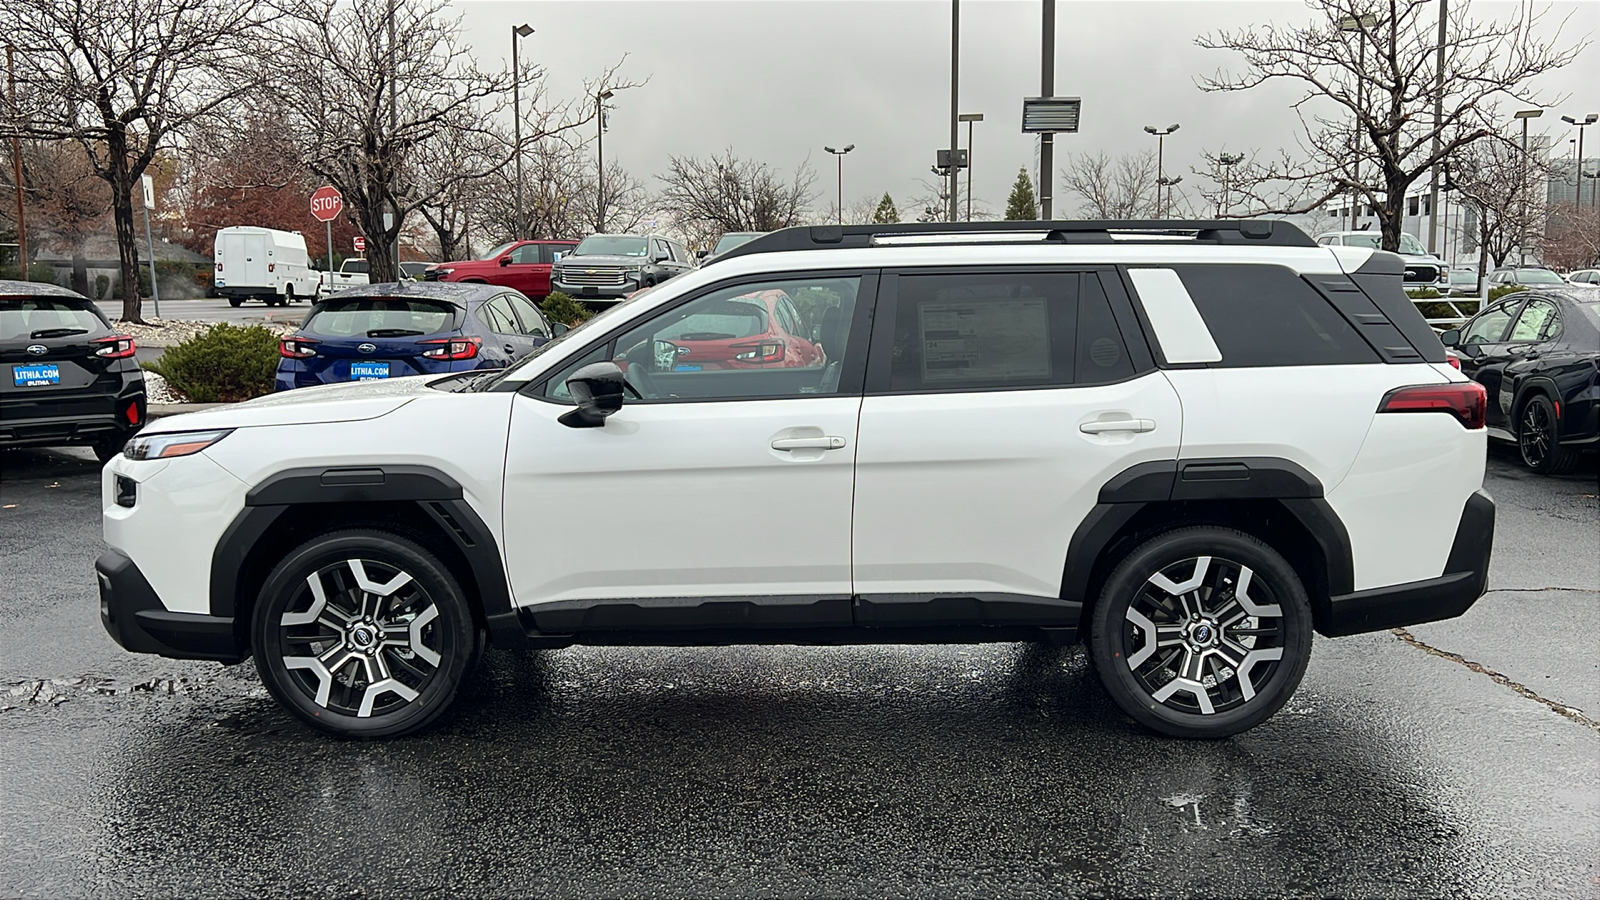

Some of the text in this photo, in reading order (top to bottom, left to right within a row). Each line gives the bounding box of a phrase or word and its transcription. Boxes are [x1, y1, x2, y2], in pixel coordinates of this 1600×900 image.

[313, 195, 340, 211] STOP
[15, 370, 60, 379] LITHIA.COM
[351, 367, 389, 375] LITHIA.COM
